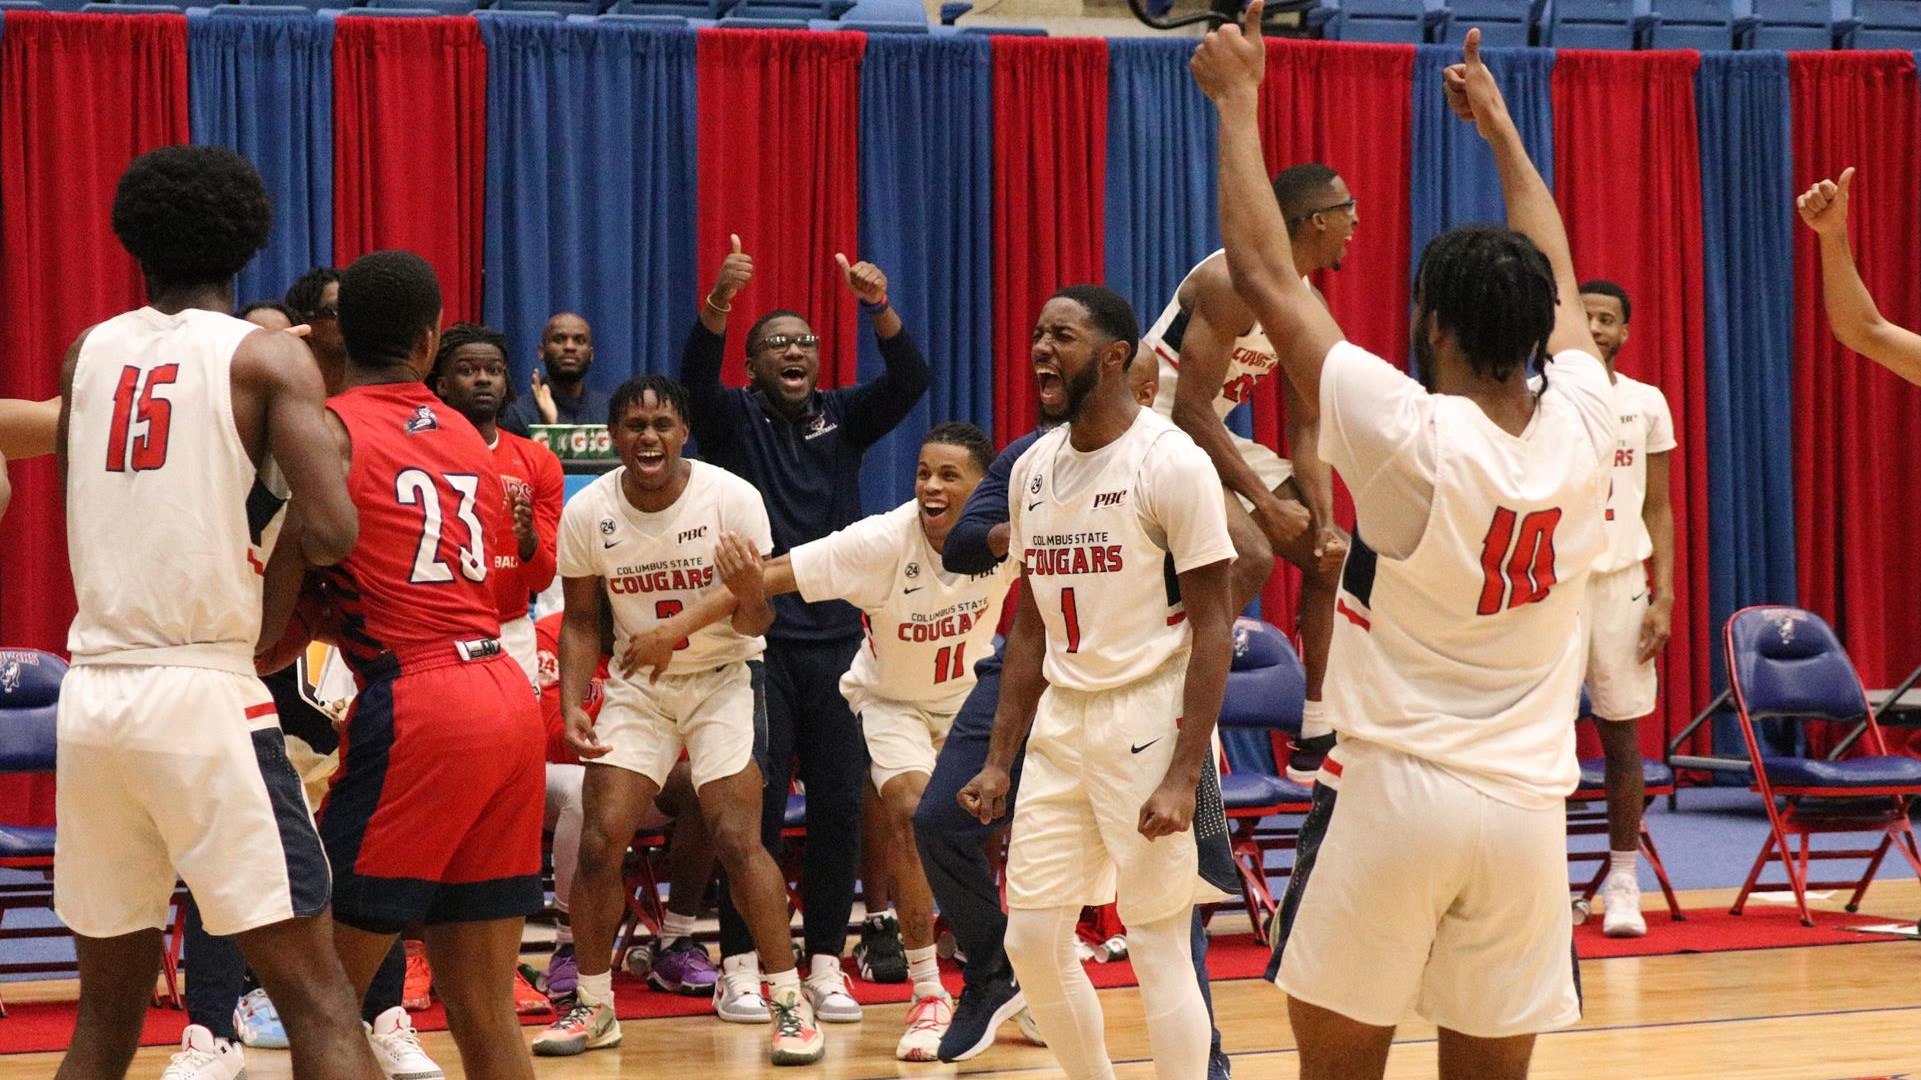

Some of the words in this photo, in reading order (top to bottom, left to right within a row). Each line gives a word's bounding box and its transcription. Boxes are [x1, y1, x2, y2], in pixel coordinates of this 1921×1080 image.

[1231, 346, 1276, 369] COUG
[105, 362, 179, 473] 15
[1093, 489, 1127, 508] PBC
[394, 465, 488, 583] 23
[602, 520, 615, 533] 24
[678, 525, 708, 544] PBC
[1075, 532, 1109, 544] STATE
[494, 555, 518, 568] BAL
[616, 561, 669, 576] COLUMBUS
[669, 557, 703, 570] STATE
[906, 564, 919, 577] 24
[1024, 545, 1123, 576] COUGARS
[1476, 505, 1562, 616] 10
[610, 565, 714, 594] COUGARS
[911, 604, 956, 623] COLUMBUS
[957, 596, 989, 612] STATE
[1061, 587, 1080, 654] 1
[933, 641, 966, 685] 11
